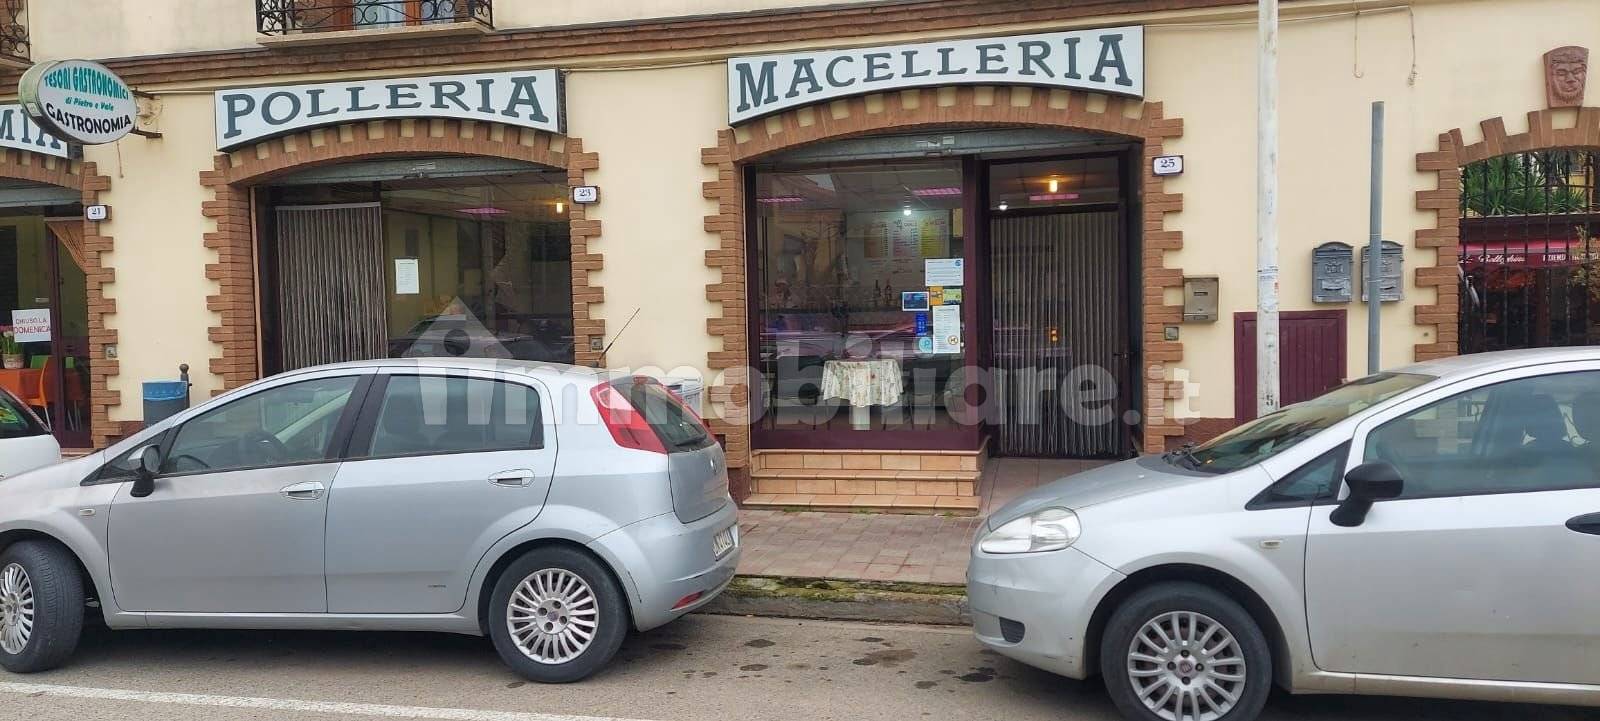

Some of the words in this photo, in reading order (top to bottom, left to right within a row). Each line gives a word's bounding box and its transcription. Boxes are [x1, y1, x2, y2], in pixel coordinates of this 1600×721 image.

[736, 34, 1132, 113] MACELLERIA
[44, 66, 71, 90] TESORI
[73, 67, 129, 100] GASTRONOMICI
[65, 96, 72, 104] di
[73, 97, 93, 107] Pietro
[222, 75, 549, 139] POLLERIA
[45, 102, 131, 134] GASTRONOMIA
[1160, 158, 1175, 168] 25
[91, 207, 101, 215] 21
[15, 317, 37, 325] CHIUSO
[14, 325, 50, 334] DOMENICA
